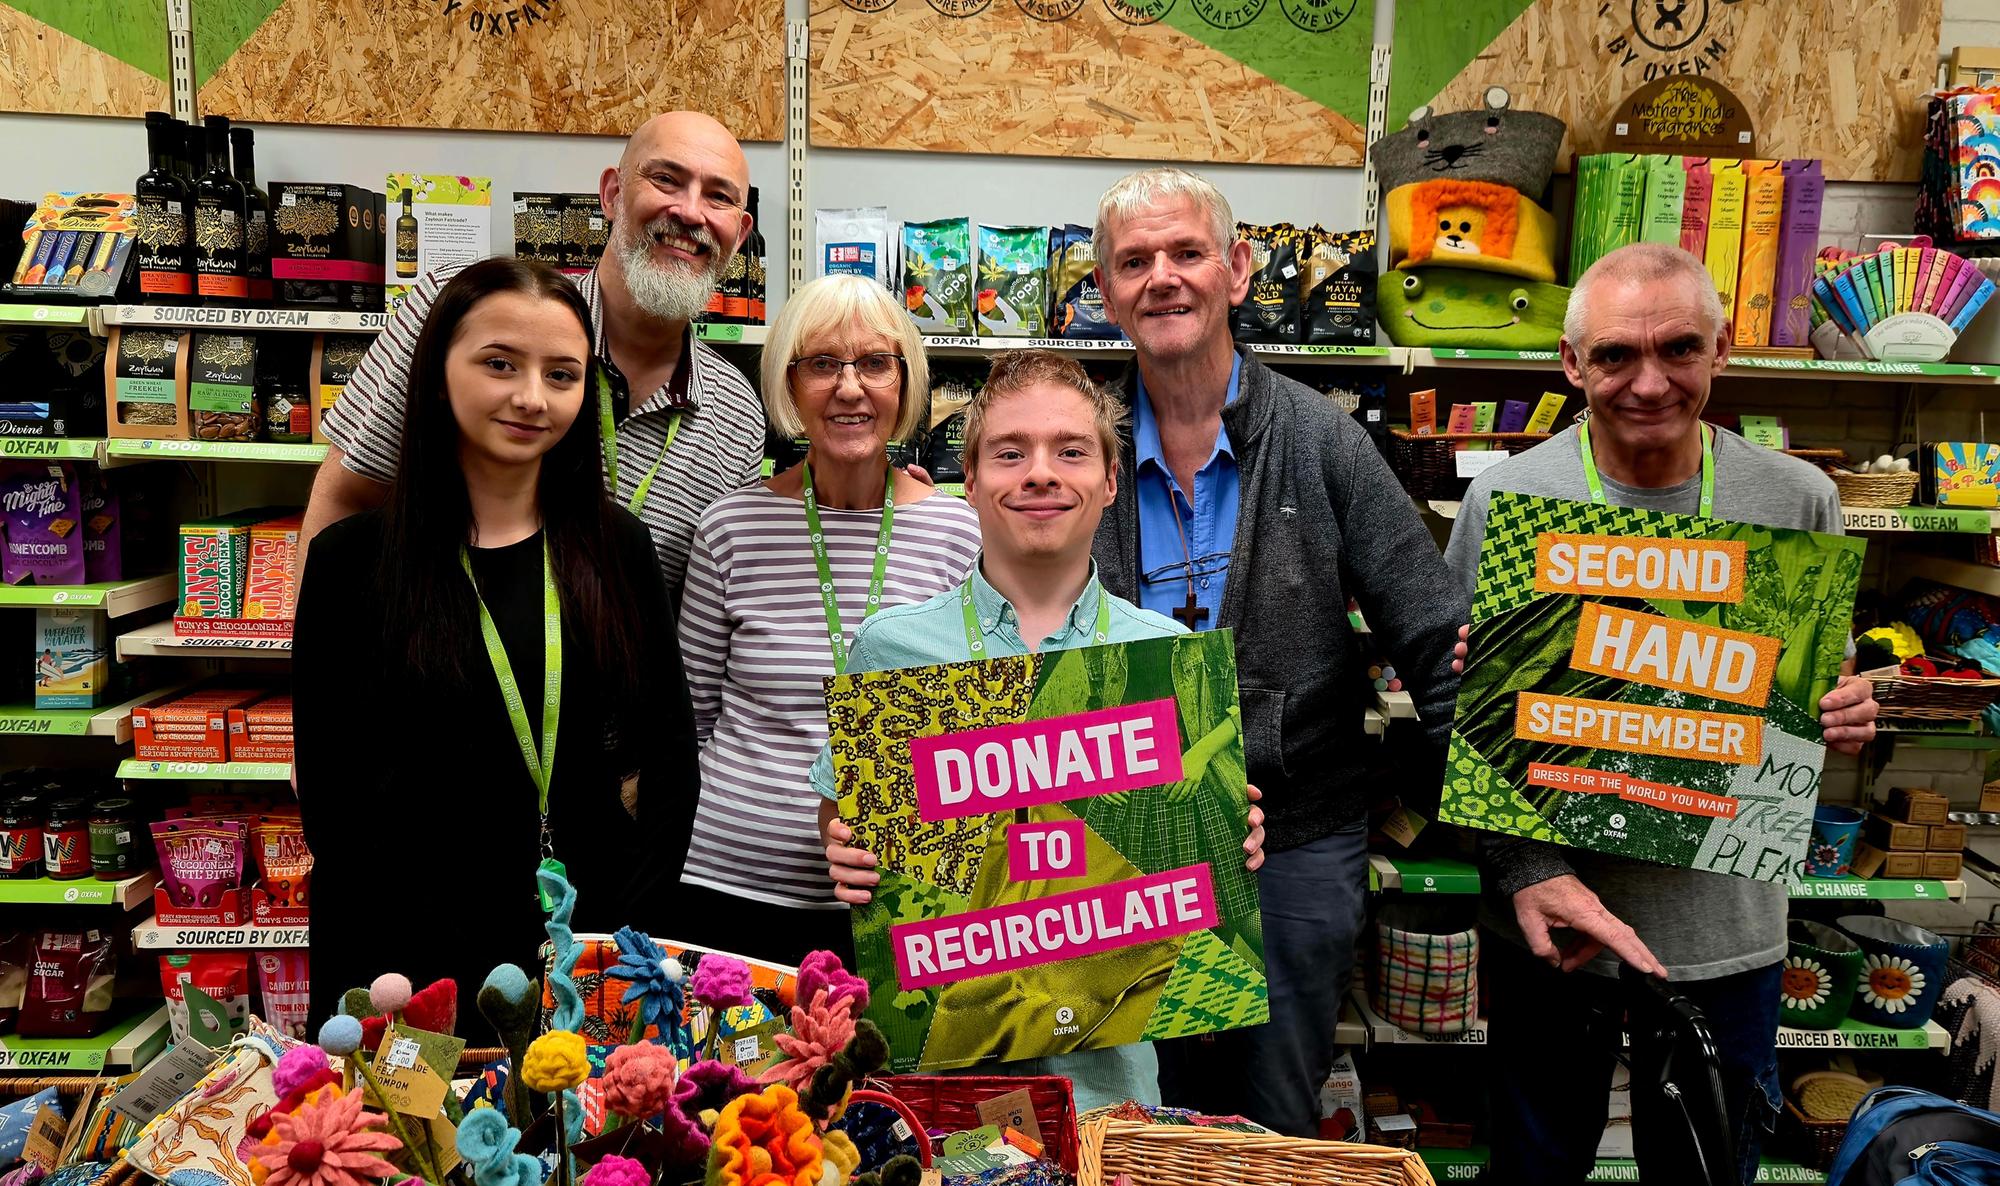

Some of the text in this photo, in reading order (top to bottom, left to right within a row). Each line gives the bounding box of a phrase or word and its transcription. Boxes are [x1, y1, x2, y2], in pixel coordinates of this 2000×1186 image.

[1291, 6, 1345, 27] THE UK
[1606, 35, 1639, 68] BY
[1672, 87, 1698, 104] The
[1632, 103, 1735, 120] Mother's India
[1643, 119, 1726, 138] Fragrances
[935, 272, 967, 305] hope
[1007, 276, 1040, 307] hope
[1325, 284, 1362, 294] MAYAN
[1330, 292, 1357, 301] GOLD
[153, 307, 309, 326] SOURCED BY OXFAM
[931, 336, 980, 346] OXFAM
[1028, 339, 1115, 348] SOURCED BY
[1286, 345, 1356, 354] BY OXFAM
[1518, 351, 1554, 360] SHOP
[1752, 358, 1805, 369] MAKING
[1806, 360, 1865, 372] LASTING
[1868, 362, 1923, 374] CHANGE
[128, 385, 163, 393] FREEKEH
[5, 440, 59, 455] OXFAM
[158, 441, 202, 452] FOOD
[1844, 514, 1958, 531] URCED BY OXFAM
[1547, 543, 1731, 594] SECOND
[181, 638, 279, 648] SOURCED BY
[1589, 614, 1758, 695] HAND
[0, 719, 52, 733] OXFAM
[1528, 701, 1746, 757] SEPTEMBER
[166, 762, 281, 775] FOOD All our new
[933, 716, 1159, 806] DONATE
[1533, 768, 1734, 815] DRESS FOR THE WORLD YOU WANT
[1603, 828, 1629, 840] OXFAM
[1020, 829, 1072, 872] TO
[205, 869, 236, 880] BITS
[1816, 883, 1868, 897] CHANGE
[902, 876, 1203, 978] RECIRCULATE
[176, 930, 309, 945] SOURCED BY OXFA
[33, 968, 65, 978] SUGAR
[35, 961, 60, 970] CANE
[268, 981, 295, 991] CANDY
[1052, 1024, 1080, 1036] OXFAM
[1833, 1029, 1850, 1047] BY
[1854, 1032, 1899, 1048] OXFAM
[19, 1051, 71, 1066] OXFAM
[1447, 1165, 1481, 1179] SHOP
[1775, 1166, 1824, 1182] CHANGE
